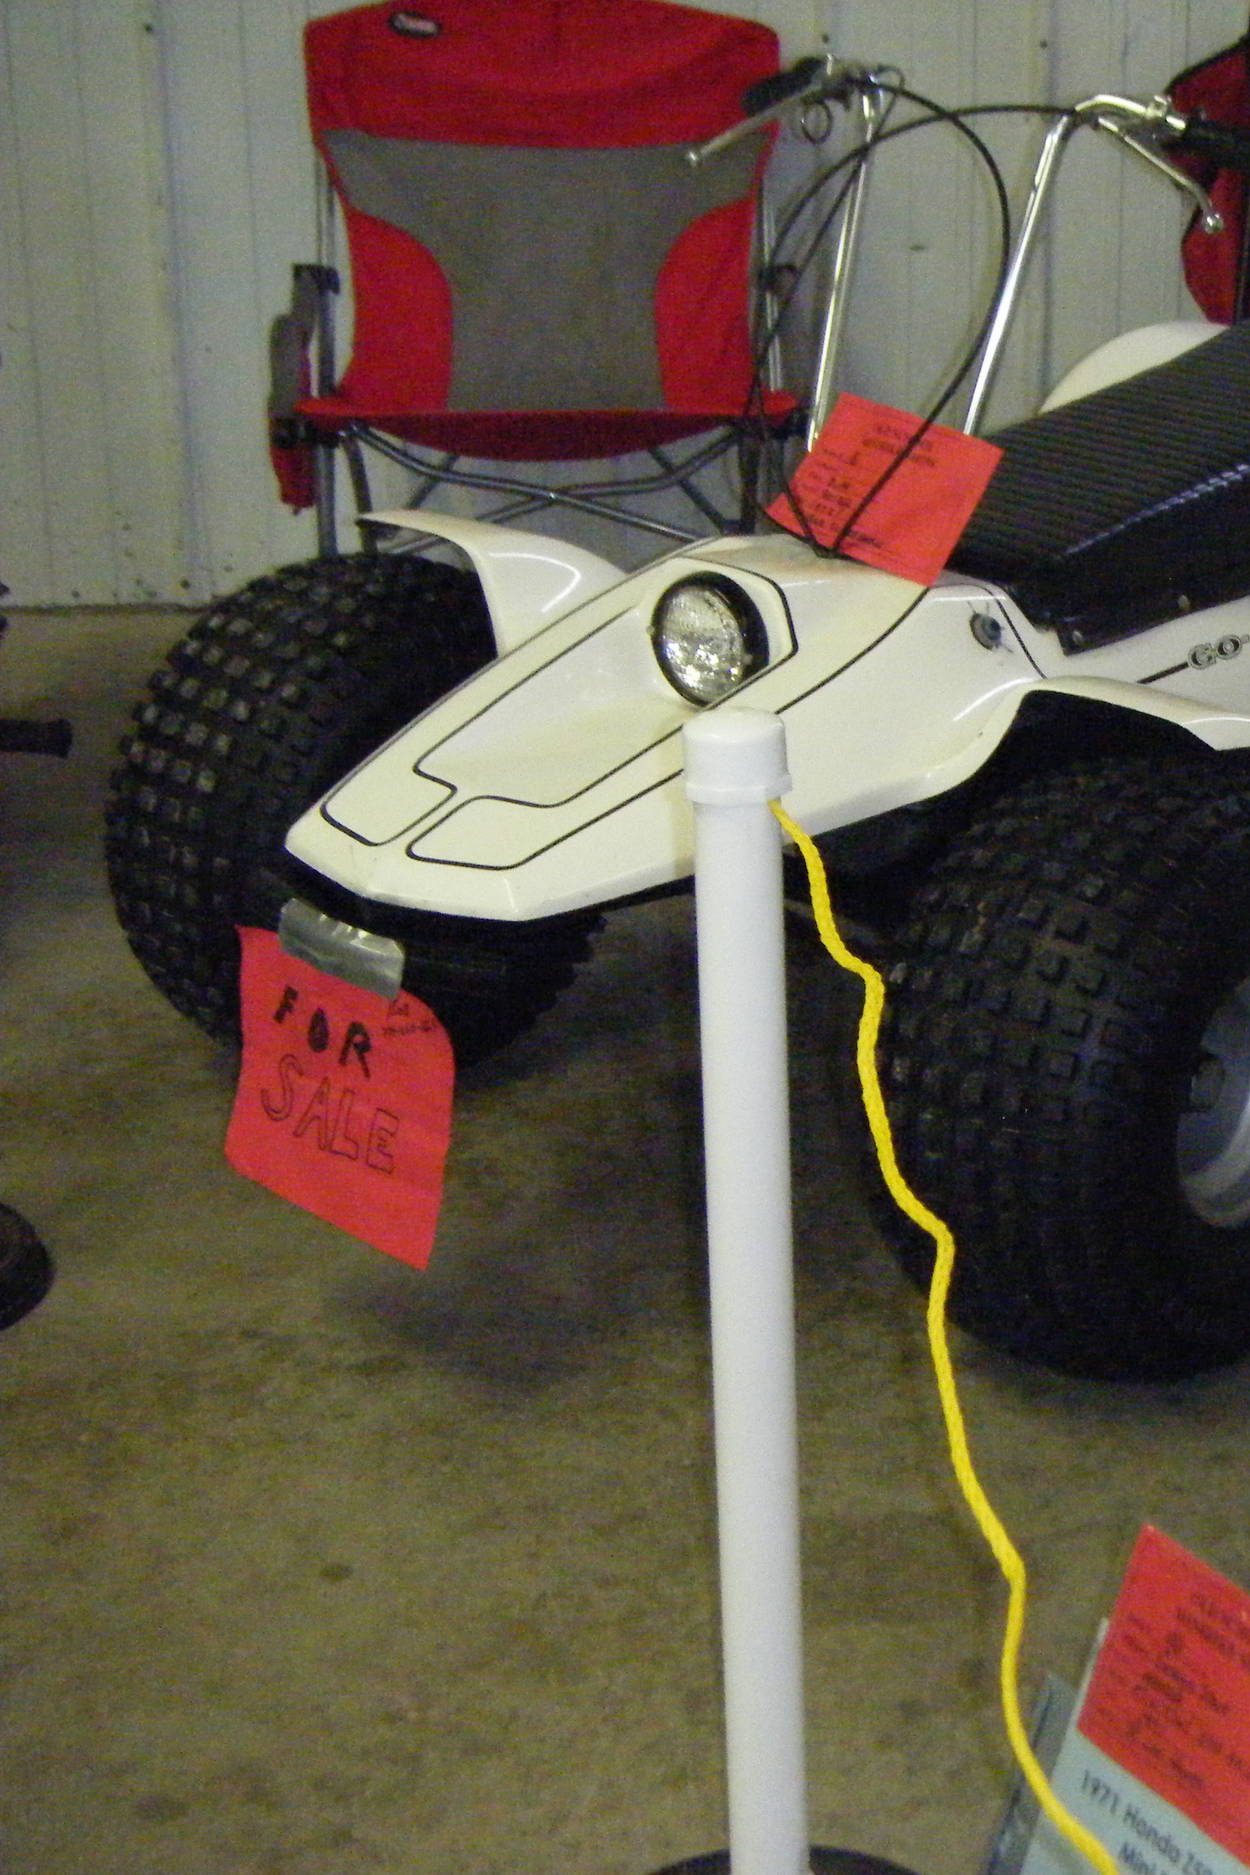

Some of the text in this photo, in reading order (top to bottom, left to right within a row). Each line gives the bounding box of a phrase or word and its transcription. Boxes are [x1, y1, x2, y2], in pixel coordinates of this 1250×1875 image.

[273, 985, 373, 1080] FOR
[259, 1053, 402, 1176] SALE
[1081, 1768, 1120, 1815] 1971
[1121, 1803, 1182, 1864] Honda
